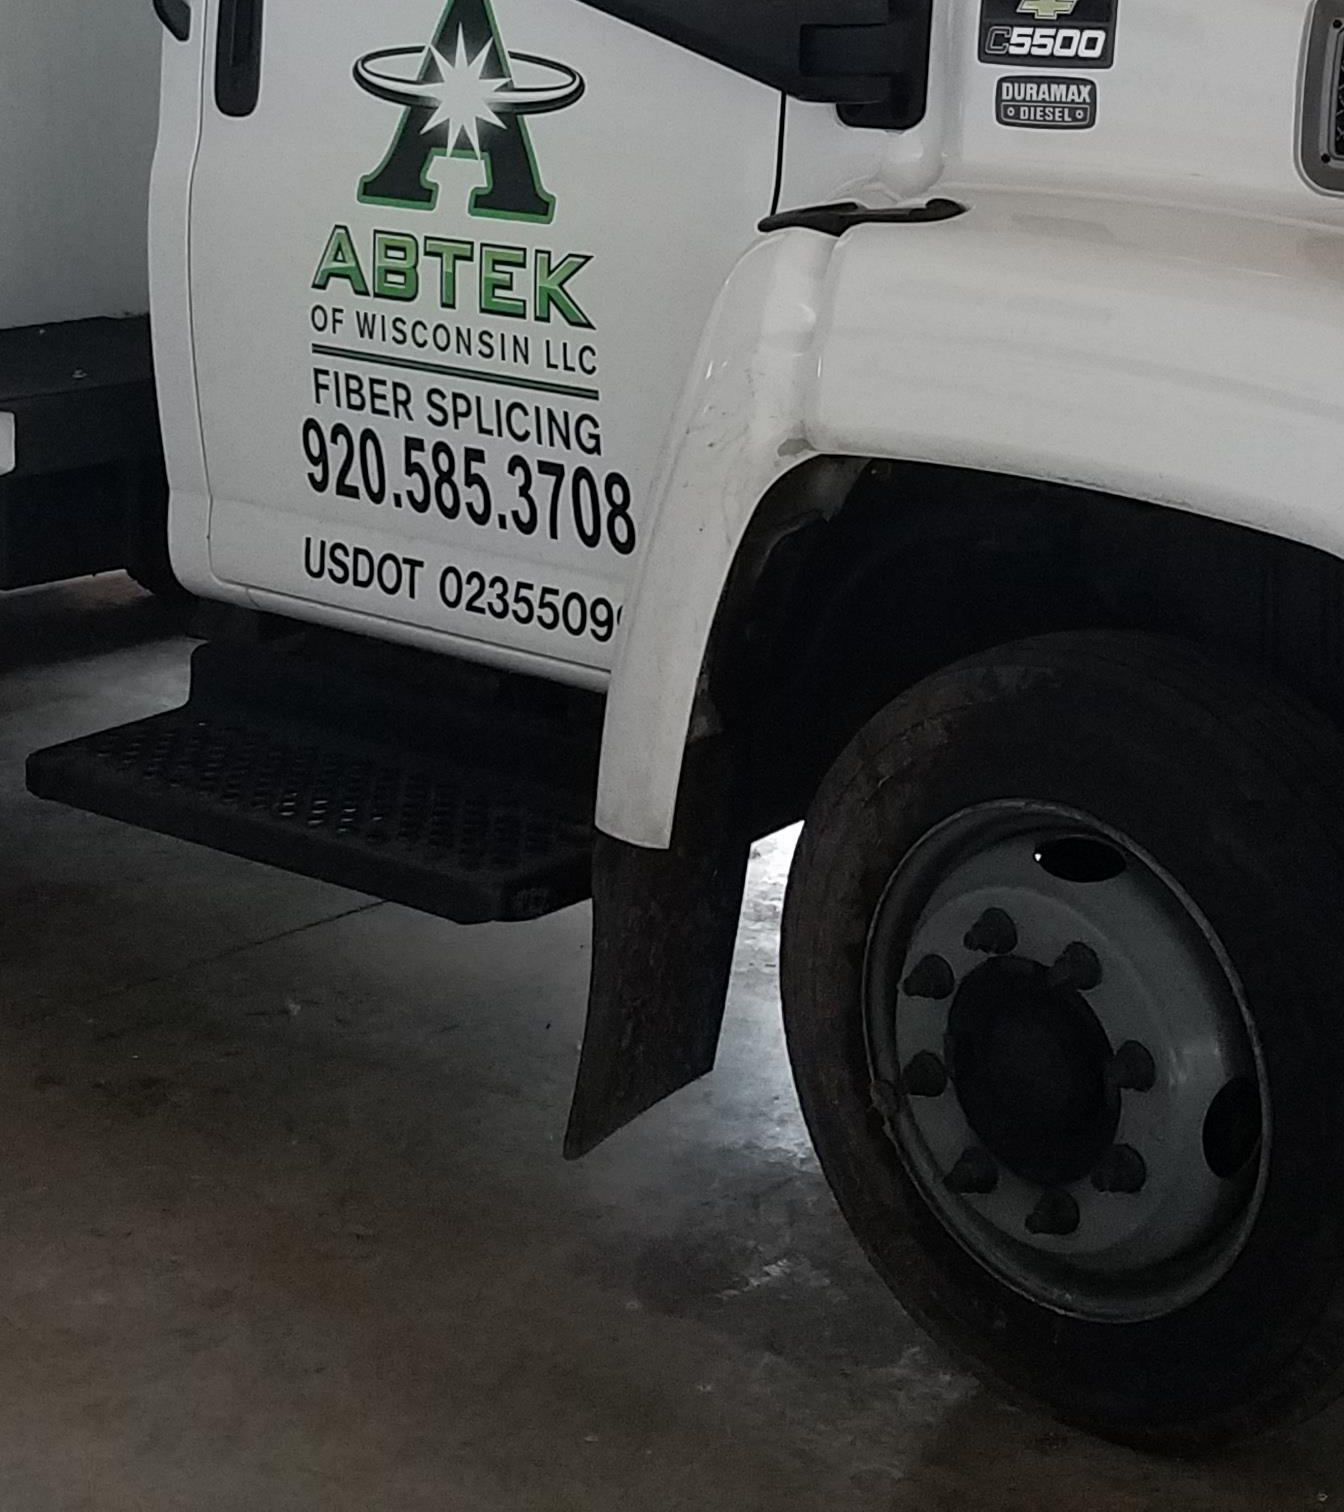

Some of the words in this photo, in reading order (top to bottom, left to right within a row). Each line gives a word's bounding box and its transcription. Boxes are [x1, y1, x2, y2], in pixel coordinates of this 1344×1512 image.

[984, 26, 1106, 58] C5500
[1001, 81, 1092, 103] DURAMAX
[1019, 106, 1073, 122] DIESEL
[311, 223, 597, 331] ABTEK
[310, 305, 345, 334] OF
[355, 310, 530, 367] WISCONSIN
[545, 339, 598, 377] LLC
[313, 368, 413, 421] FIBER
[426, 388, 602, 457] SPLICING
[302, 417, 637, 556] 920.585.3708
[304, 535, 425, 601] USDOT
[439, 565, 623, 644] 0235509
